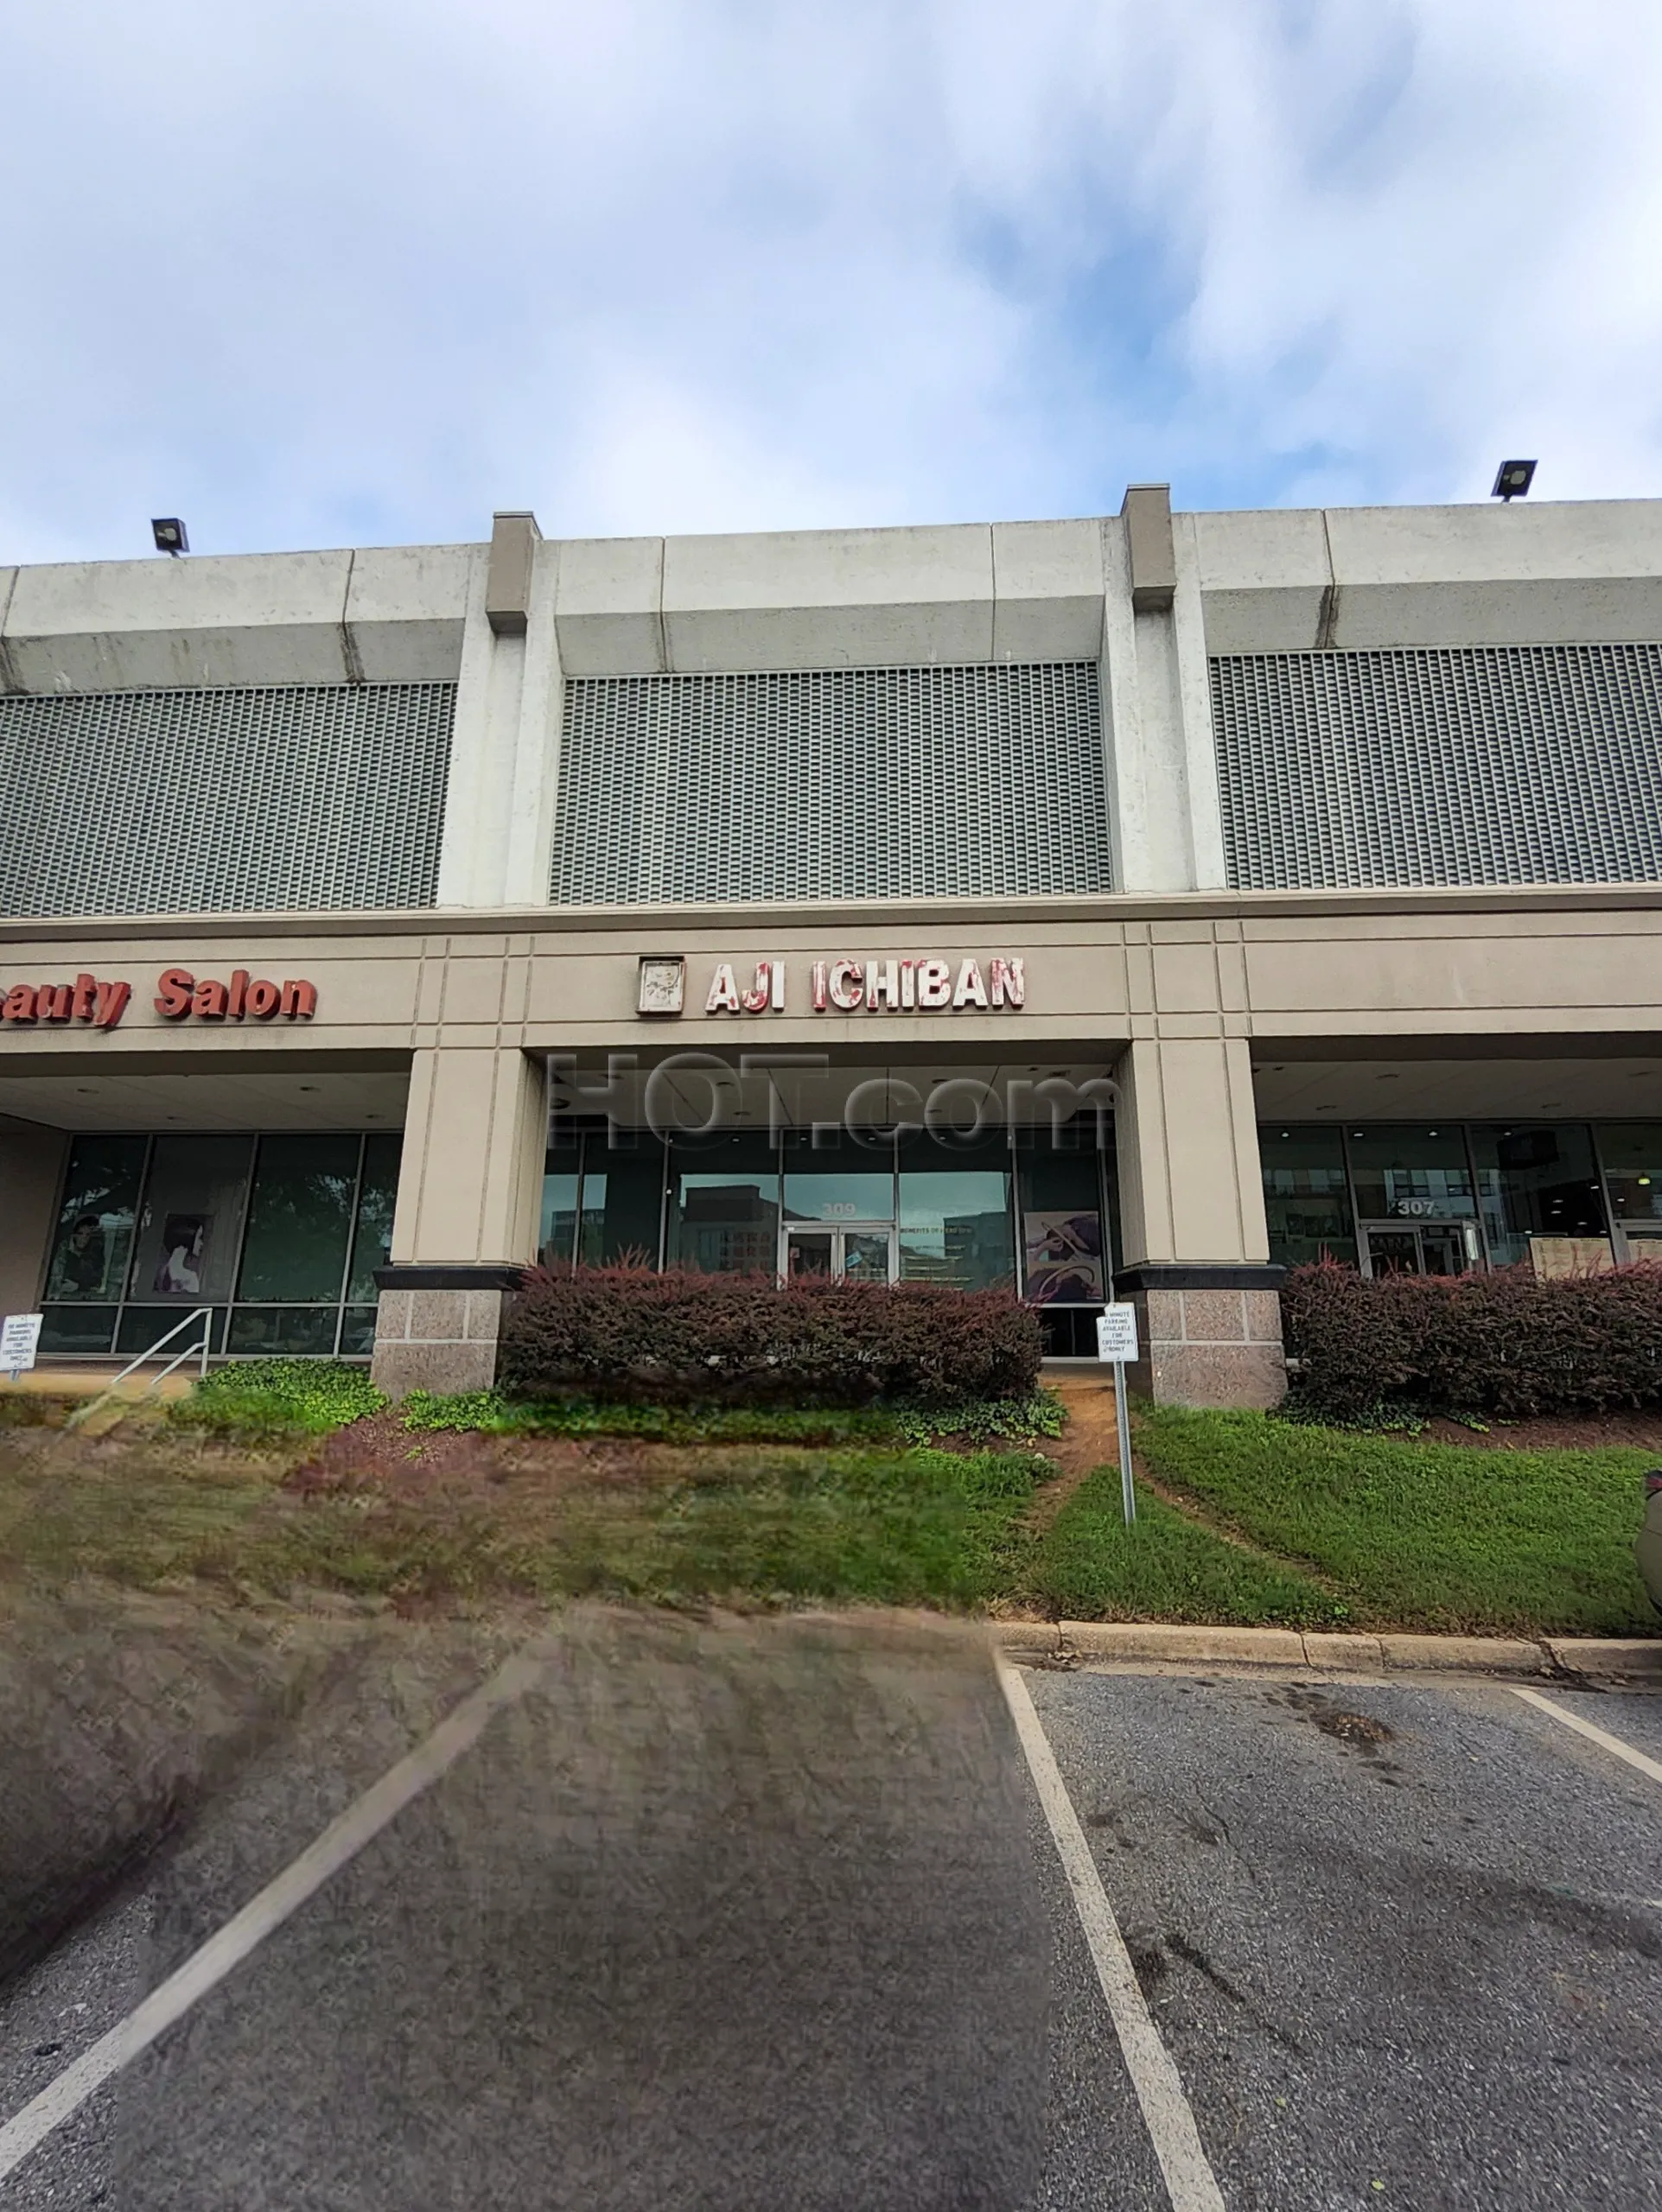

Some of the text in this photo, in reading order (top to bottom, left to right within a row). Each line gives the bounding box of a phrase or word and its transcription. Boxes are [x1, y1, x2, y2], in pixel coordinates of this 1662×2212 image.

[0, 968, 318, 1026] auty Salon
[704, 957, 1025, 1011] AJI ICHIBAN
[823, 1202, 856, 1217] 309
[1398, 1200, 1434, 1215] 307
